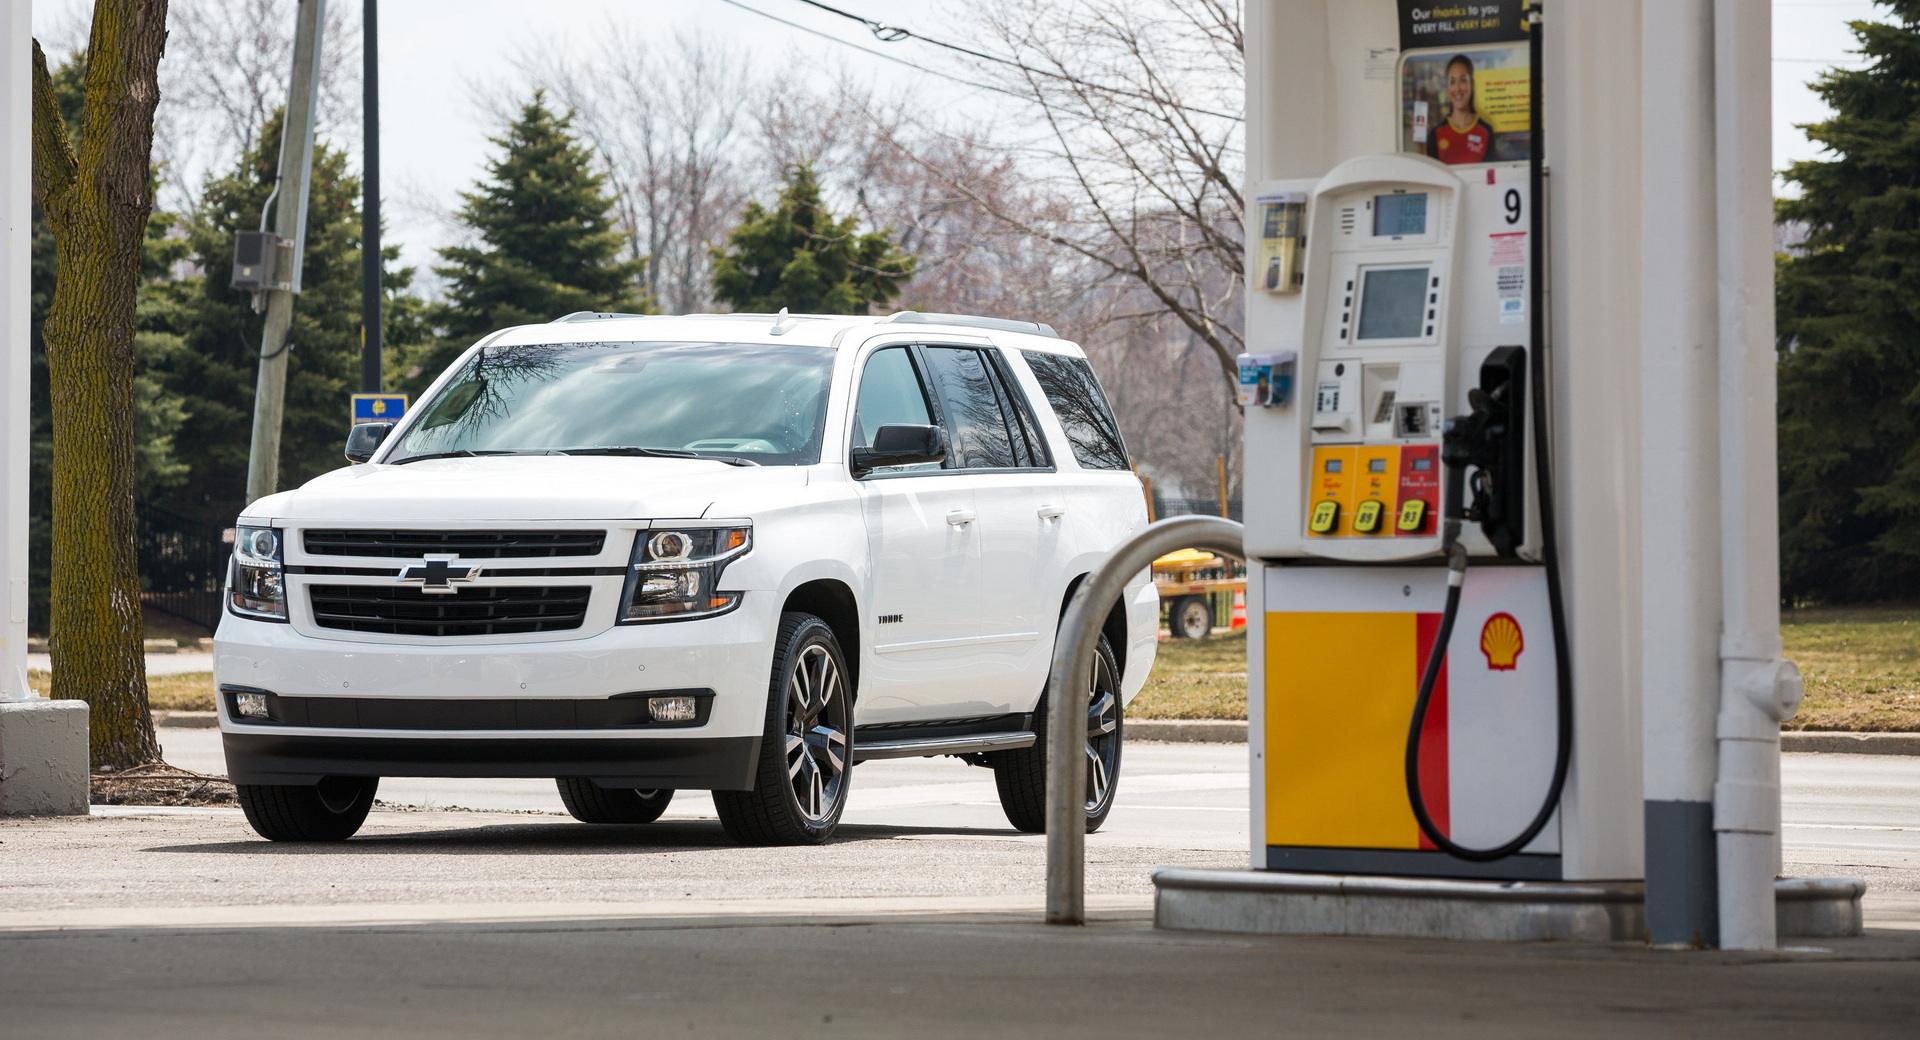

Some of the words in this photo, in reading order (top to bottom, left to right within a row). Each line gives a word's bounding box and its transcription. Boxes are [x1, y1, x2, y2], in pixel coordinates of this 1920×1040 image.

[1412, 8, 1431, 20] Our
[1432, 5, 1467, 19] thanks
[1468, 6, 1479, 17] to
[1480, 5, 1500, 17] you
[1413, 22, 1437, 34] EVERY
[1455, 20, 1479, 31] EVERY
[1505, 188, 1522, 225] 9
[1315, 512, 1330, 524] 87
[1358, 512, 1373, 524] 89
[1404, 511, 1418, 523] 93
[878, 614, 904, 624] TAHOE
